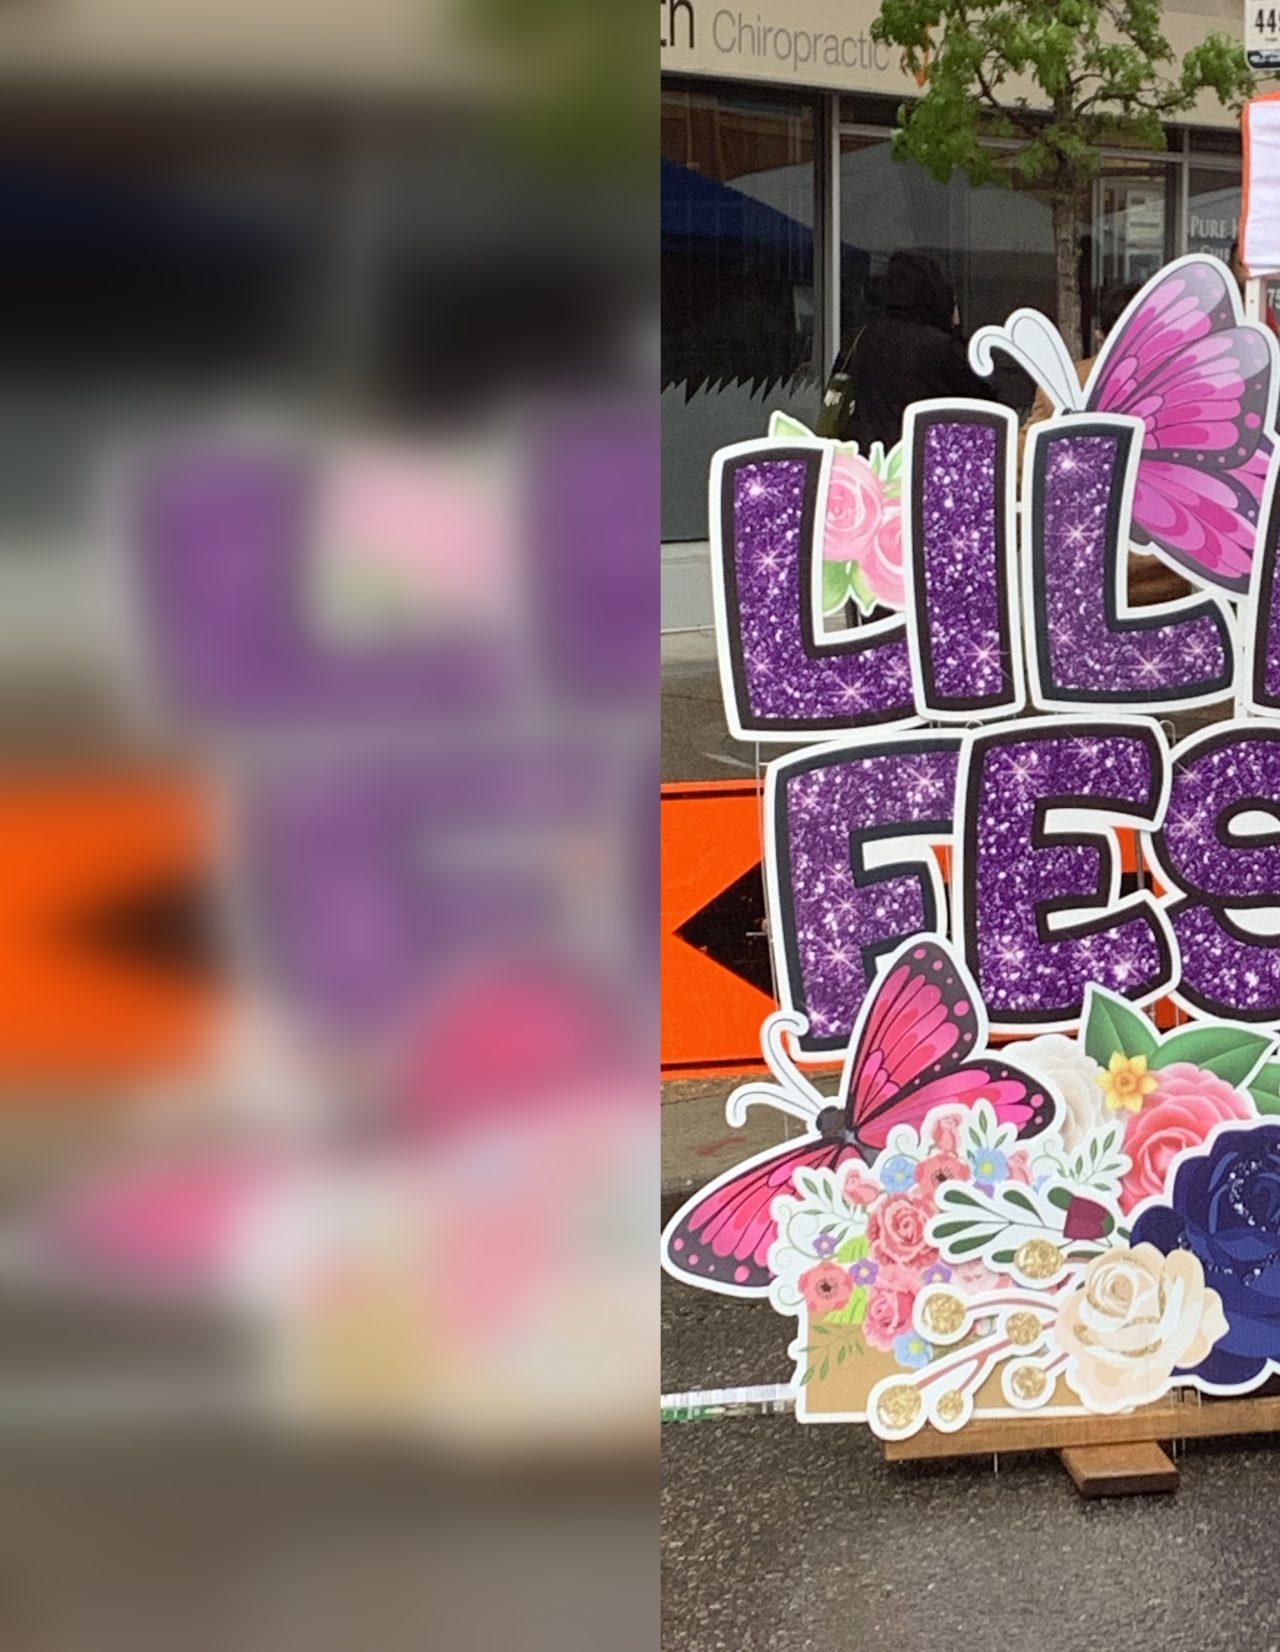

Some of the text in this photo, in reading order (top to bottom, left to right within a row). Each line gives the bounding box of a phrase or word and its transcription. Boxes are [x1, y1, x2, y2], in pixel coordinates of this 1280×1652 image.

[661, 0, 890, 71] h Chiropractic
[1190, 216, 1227, 238] PURE
